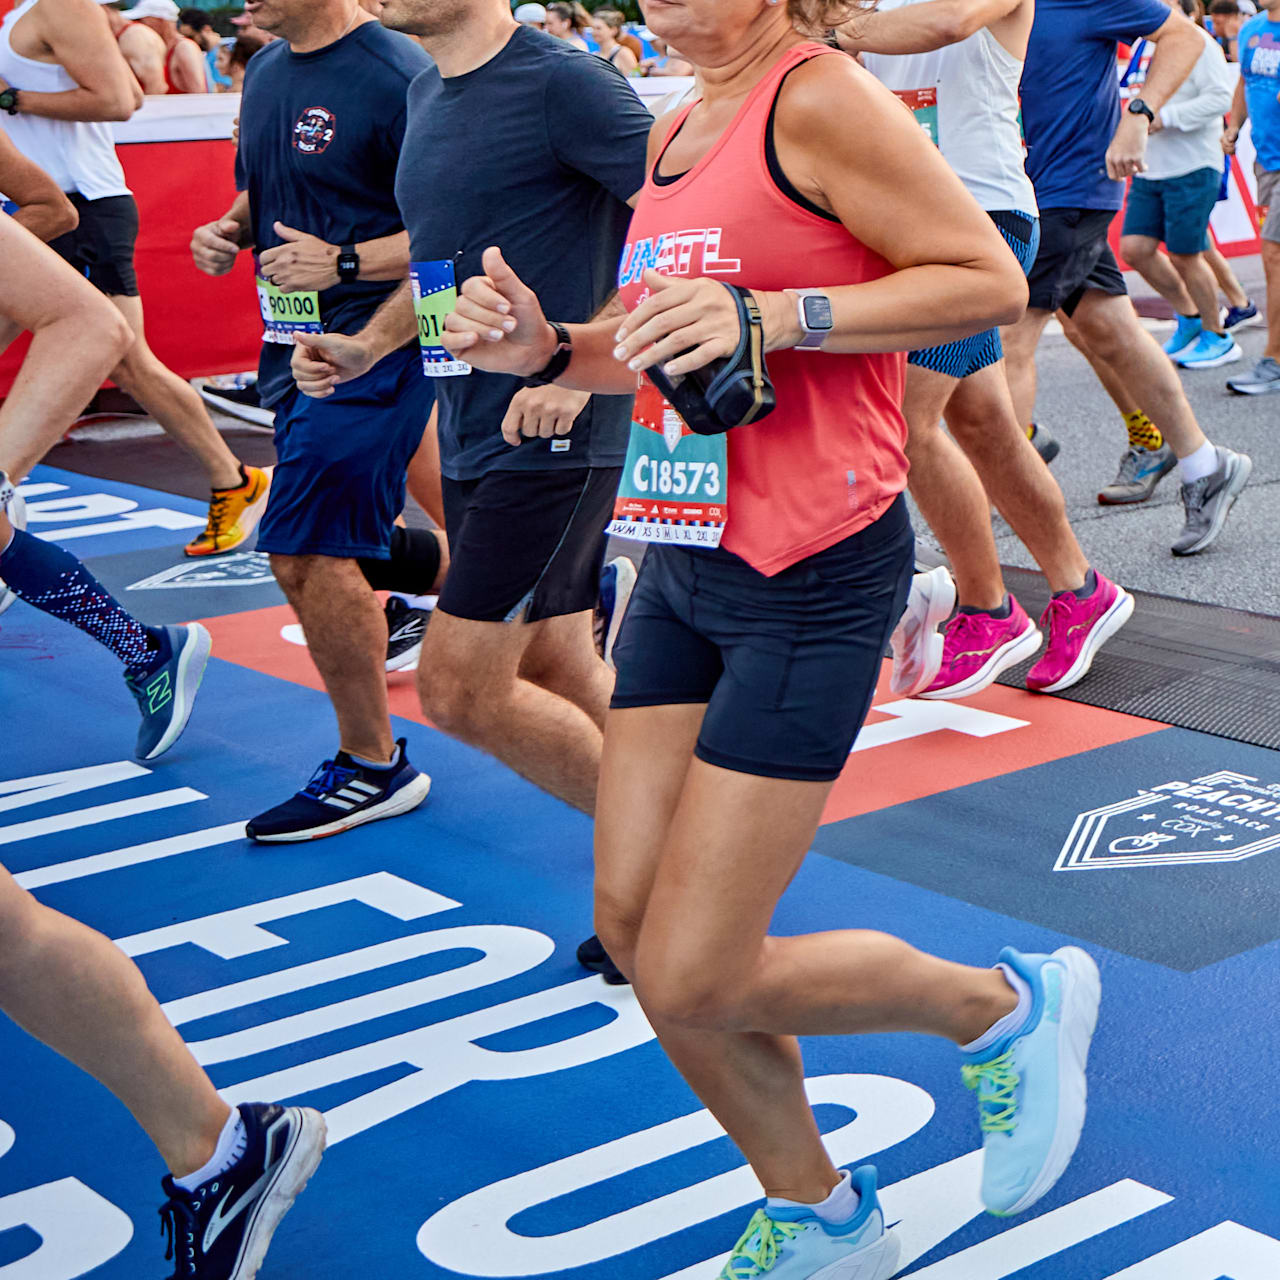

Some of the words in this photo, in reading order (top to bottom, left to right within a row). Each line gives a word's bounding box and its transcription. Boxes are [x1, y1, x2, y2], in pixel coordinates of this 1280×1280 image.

[619, 227, 741, 286] UNATL
[269, 295, 314, 315] 90100
[633, 455, 720, 496] C18573
[643, 526, 652, 537] XS
[656, 527, 661, 538] S
[675, 529, 680, 539] L
[683, 530, 692, 540] XL
[697, 531, 708, 542] 2XL
[1161, 820, 1213, 838] COX
[1173, 802, 1221, 818] ROAD
[1224, 814, 1272, 832] RACE
